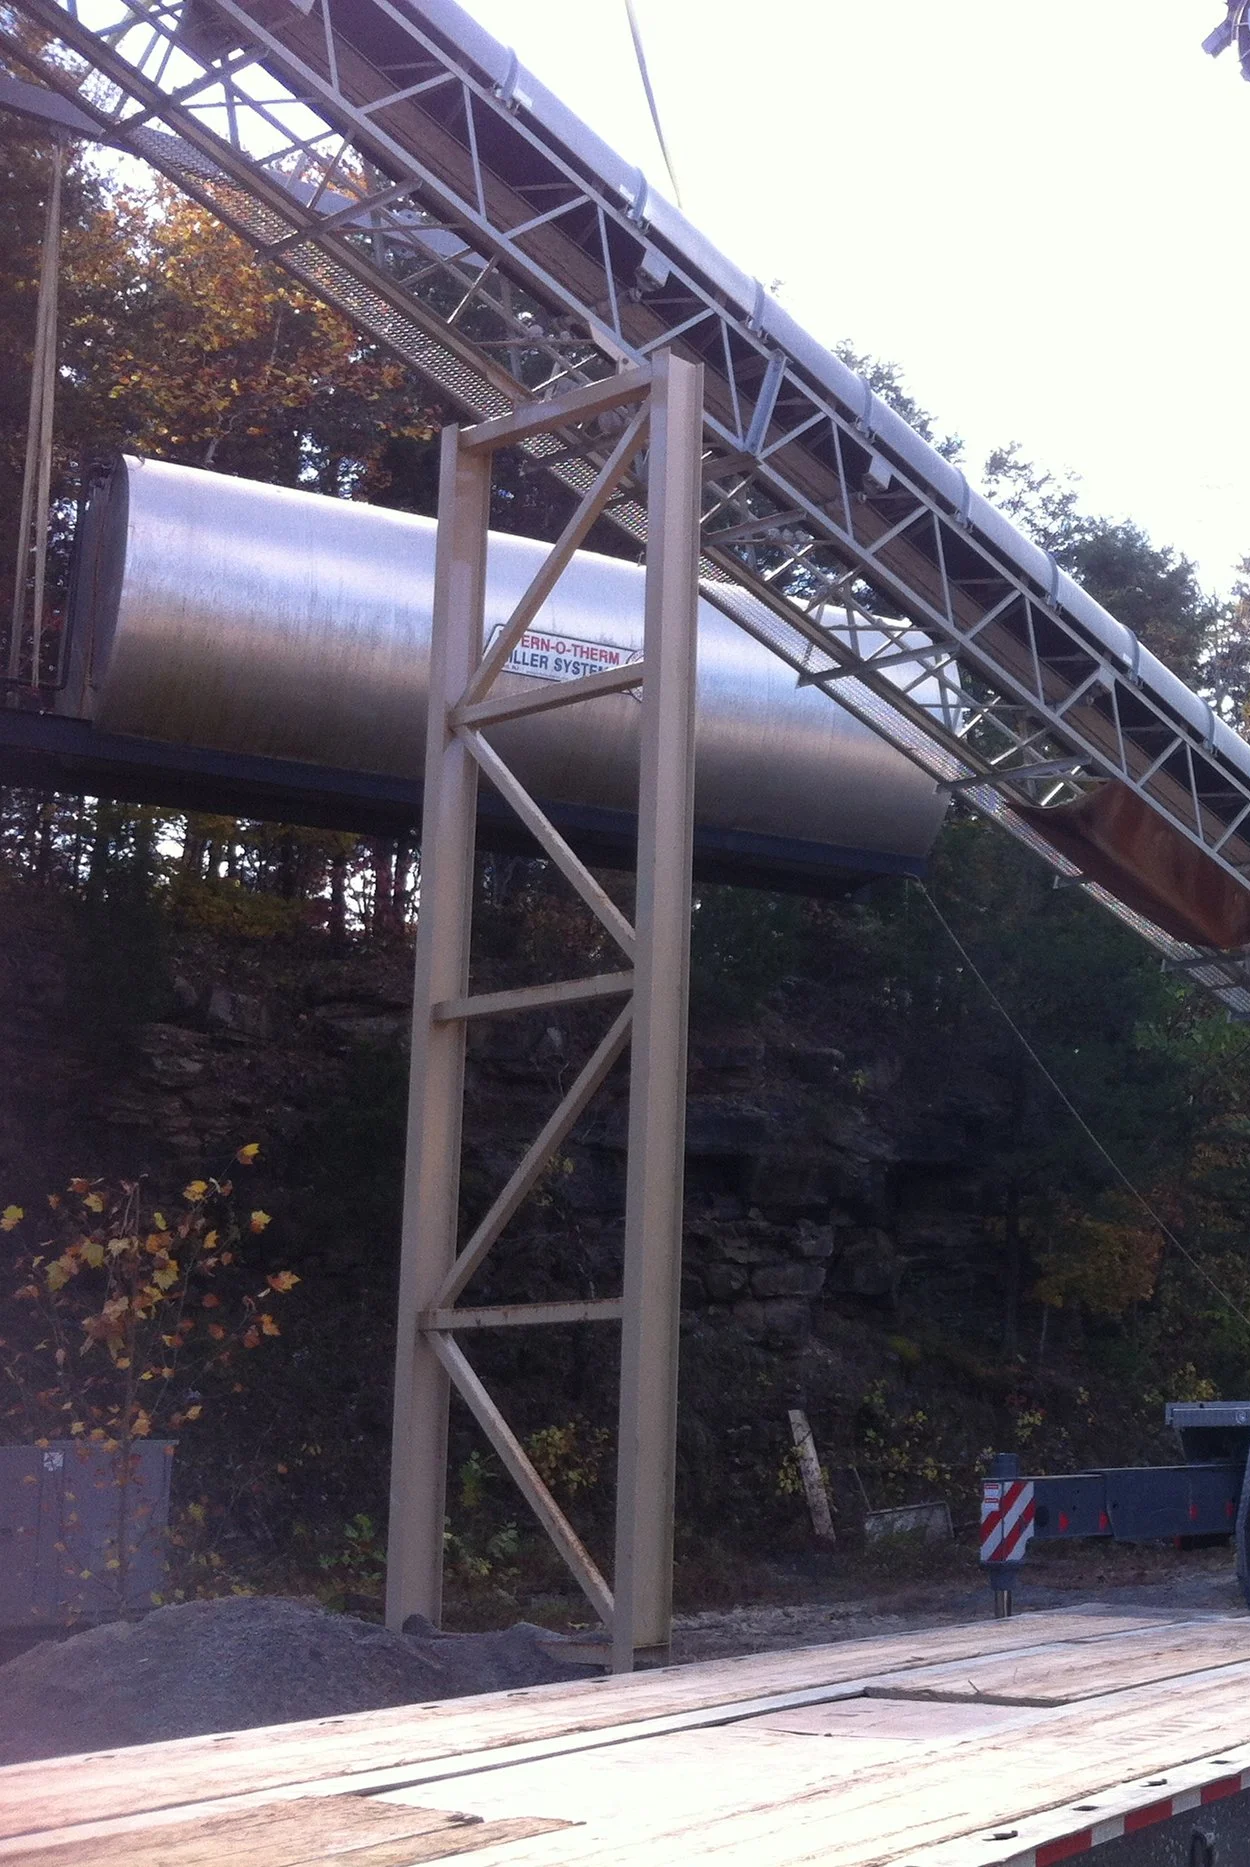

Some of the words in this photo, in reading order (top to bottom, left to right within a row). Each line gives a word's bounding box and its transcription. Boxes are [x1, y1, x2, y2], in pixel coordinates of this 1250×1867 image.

[509, 649, 548, 670] ILLER
[554, 657, 606, 676] SYSTE
[521, 634, 620, 665] ERN-O-THERM
